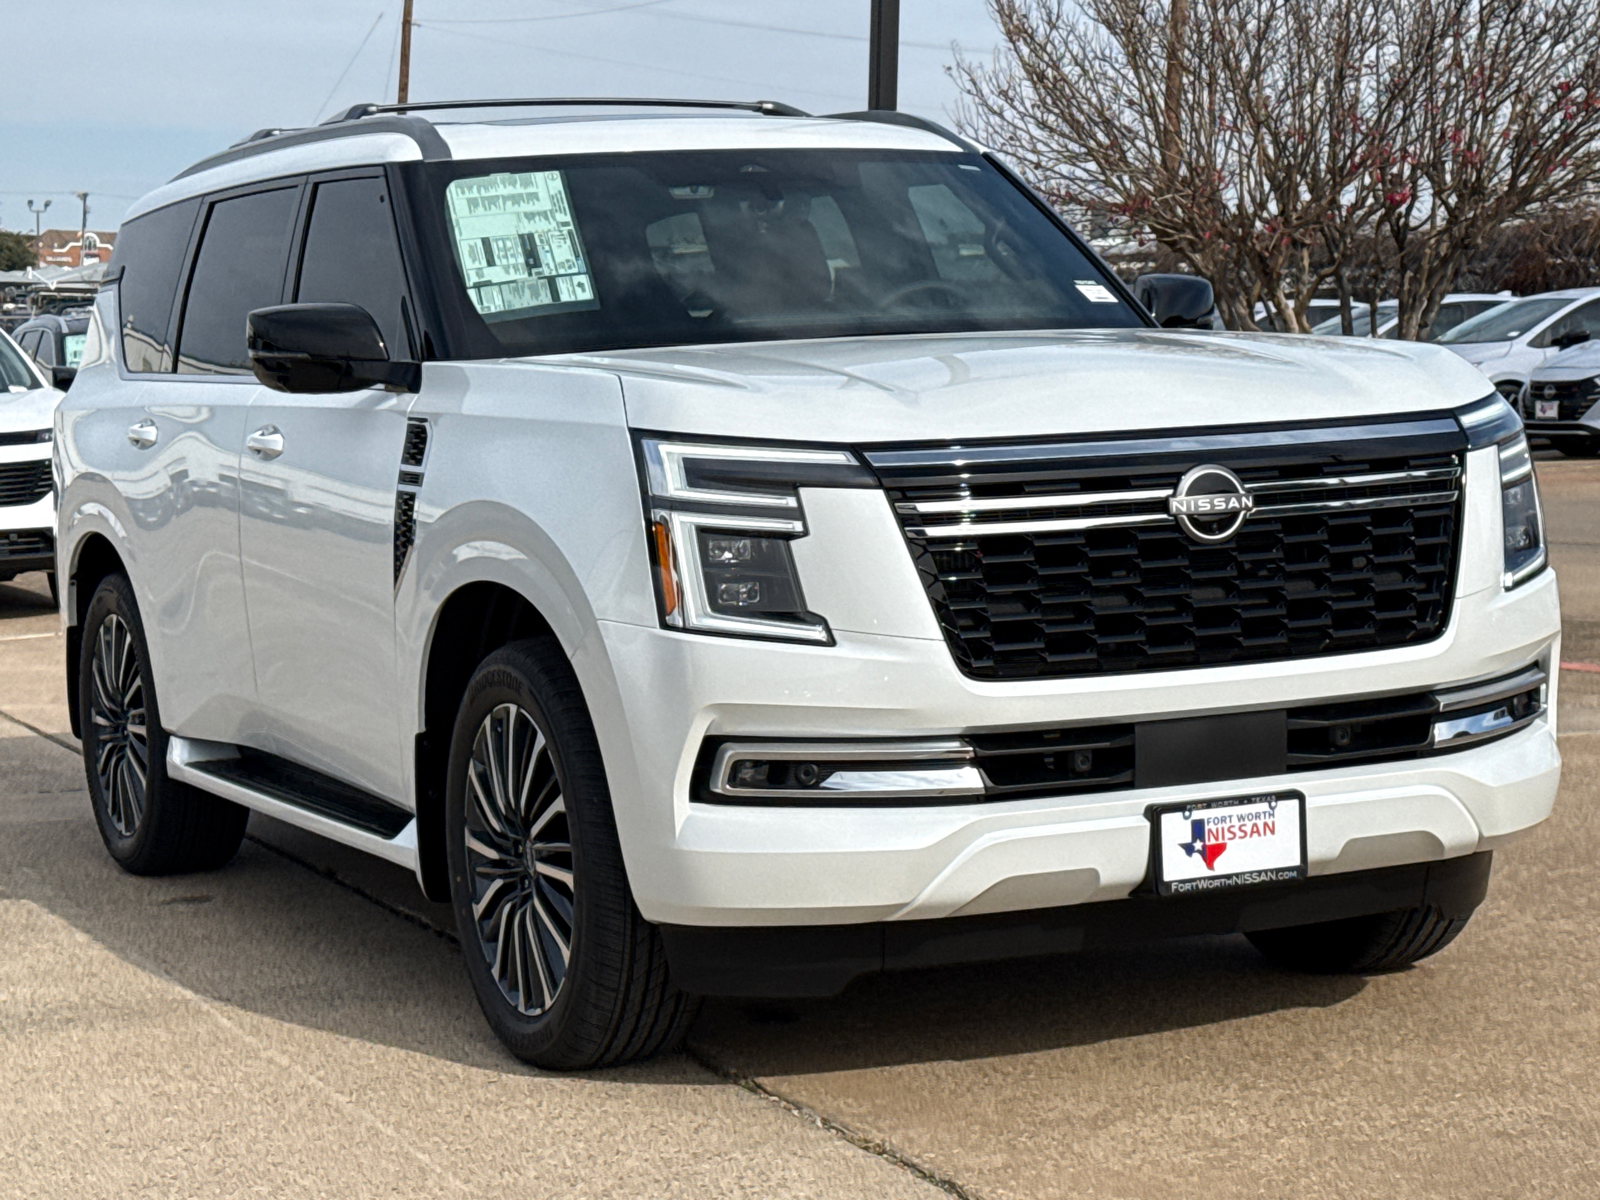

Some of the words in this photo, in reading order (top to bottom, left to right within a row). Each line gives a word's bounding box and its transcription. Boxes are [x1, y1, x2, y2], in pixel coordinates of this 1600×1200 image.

[1172, 495, 1253, 513] NISSAN
[1186, 803, 1207, 811] FORT
[1211, 800, 1239, 808] WORTH
[1251, 795, 1276, 803] TEXAS
[1206, 814, 1234, 826] FORT
[1236, 810, 1275, 823] WORTH
[1207, 820, 1276, 843] NISSAN
